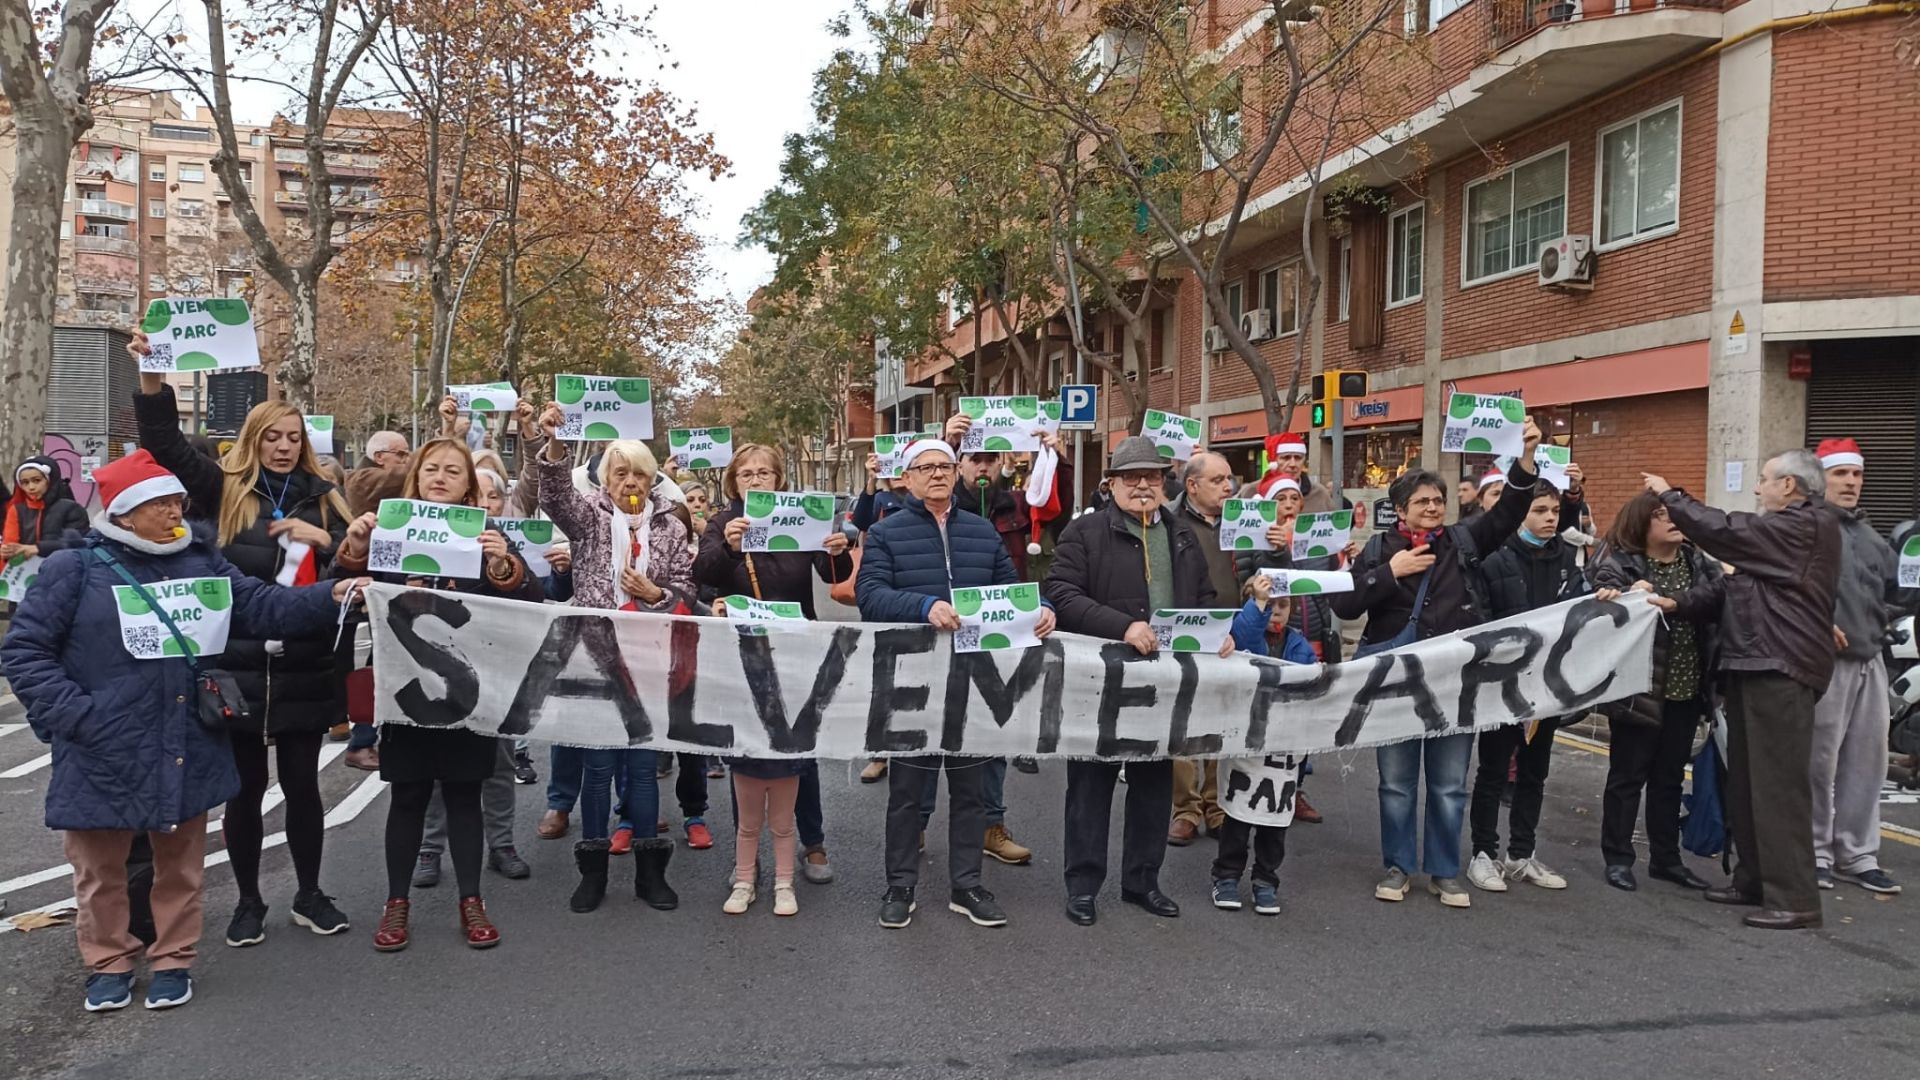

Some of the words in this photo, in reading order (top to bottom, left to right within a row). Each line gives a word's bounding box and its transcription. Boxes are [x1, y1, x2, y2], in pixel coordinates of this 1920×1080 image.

[146, 301, 209, 316] SALVEM
[215, 300, 235, 310] EL
[172, 323, 217, 340] PARC
[566, 378, 617, 392] SALVEM
[622, 381, 639, 392] EL
[583, 400, 621, 412] PARC
[968, 399, 1011, 410] SALVEM
[1015, 399, 1029, 408] EL
[1067, 389, 1089, 418] P
[1458, 395, 1502, 409] SALVEM
[1505, 401, 1517, 411] EL
[985, 417, 1015, 427] PARC
[1152, 413, 1184, 426] SALVEM
[1471, 417, 1503, 429] PARC
[1160, 429, 1184, 441] PARC
[689, 442, 713, 451] PARC
[756, 494, 805, 508] SALVEM
[1230, 502, 1259, 511] SALVEM
[389, 502, 449, 521] SALVEM
[454, 509, 473, 523] EL
[528, 521, 544, 532] EL
[771, 516, 806, 526] PARC
[1239, 518, 1262, 528] PARC
[406, 528, 449, 543] PARC
[1311, 528, 1333, 538] PARC
[202, 581, 219, 595] EL
[962, 588, 1010, 602] SALVEM
[1014, 587, 1029, 599] EL
[162, 607, 202, 623] ARC
[777, 605, 791, 614] EL
[981, 609, 1015, 623] PARC
[1174, 615, 1207, 626] PARC
